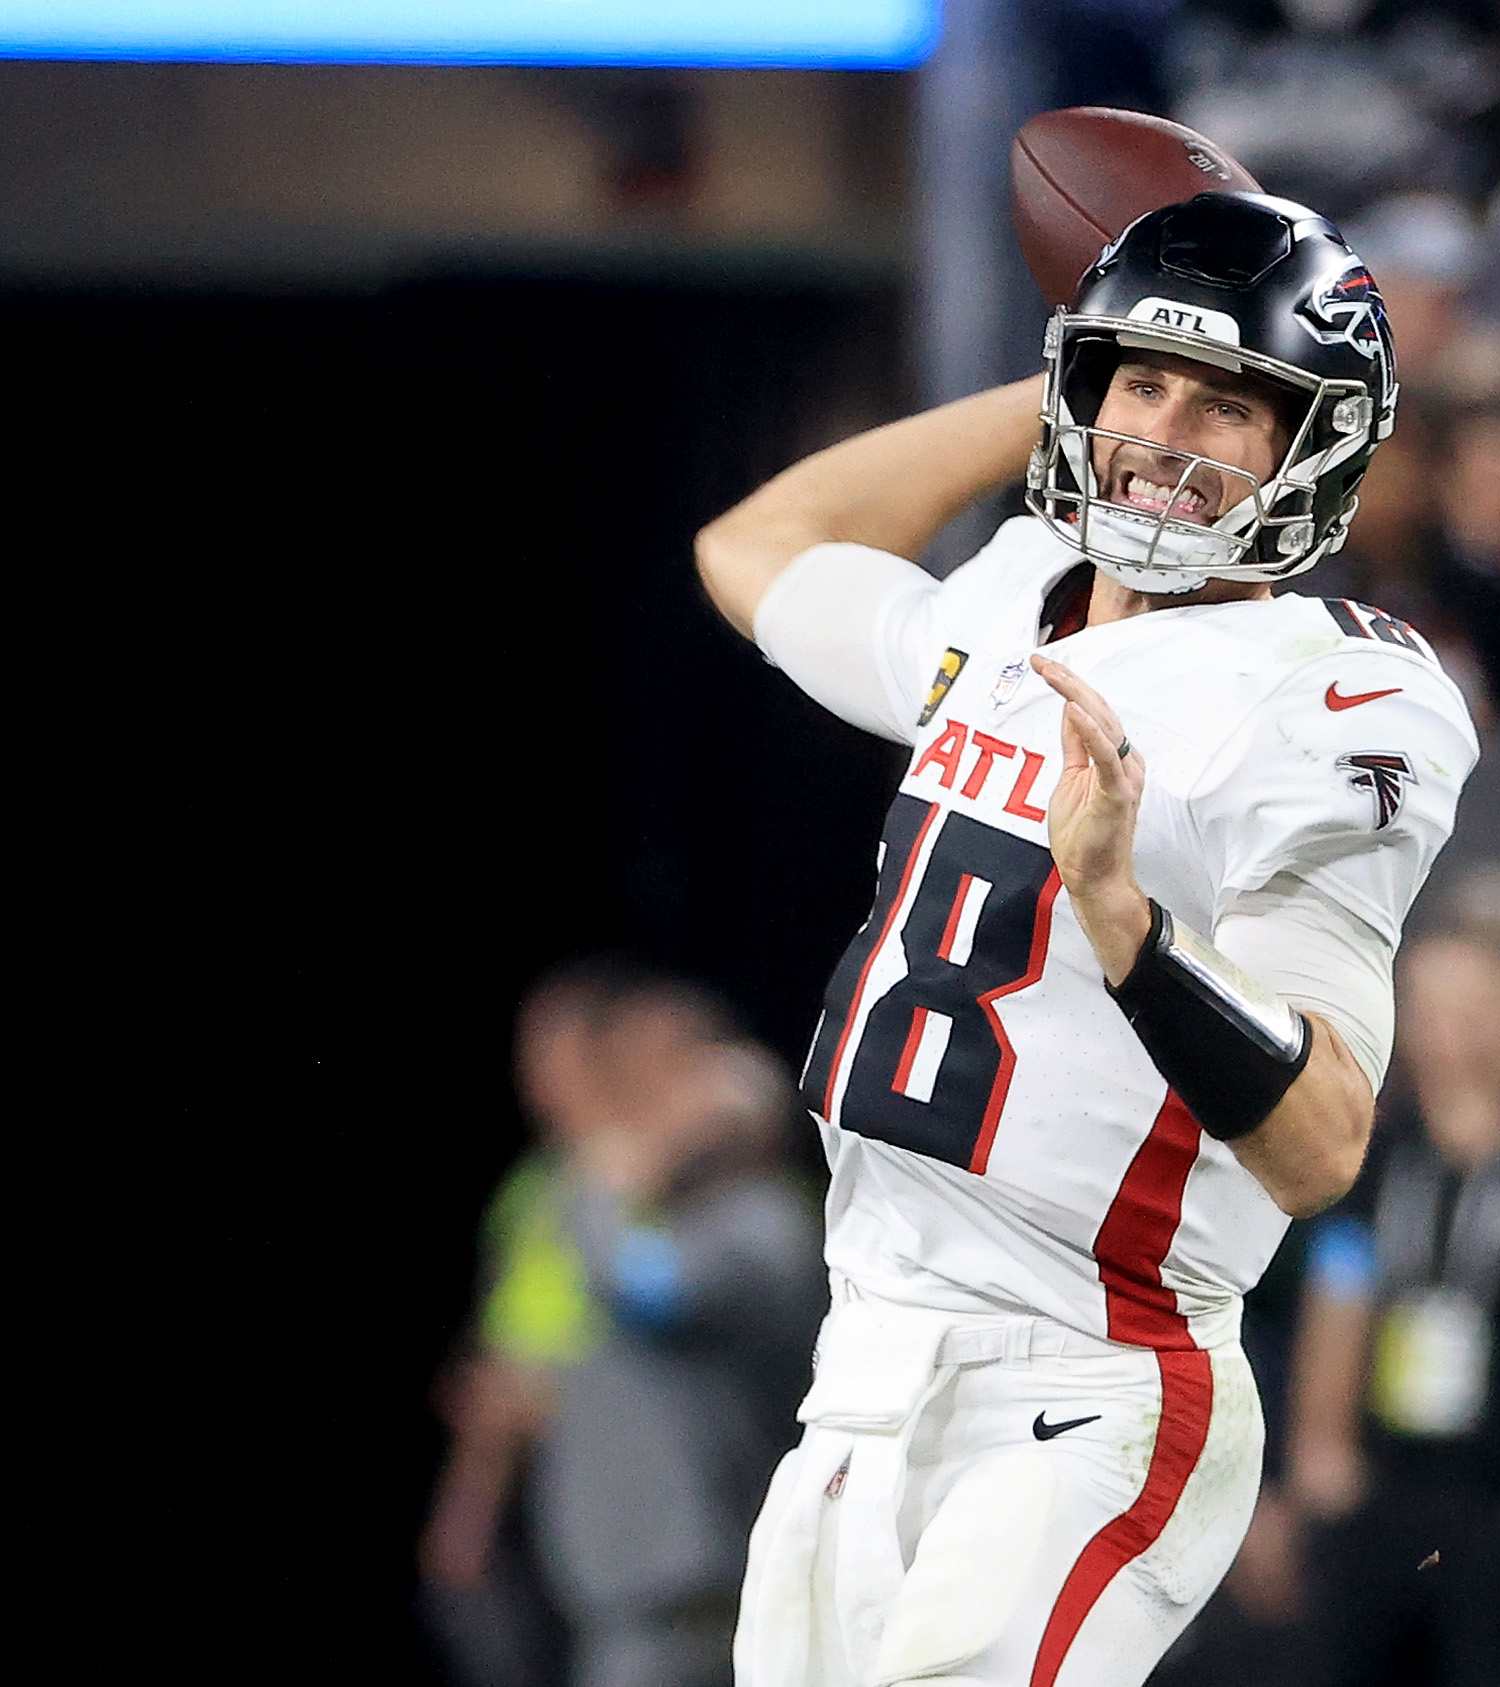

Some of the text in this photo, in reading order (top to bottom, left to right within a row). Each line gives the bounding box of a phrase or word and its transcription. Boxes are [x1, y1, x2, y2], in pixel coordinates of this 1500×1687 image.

[1151, 307, 1206, 334] ATL
[911, 718, 1047, 823] ATL
[798, 787, 1064, 1177] 18
